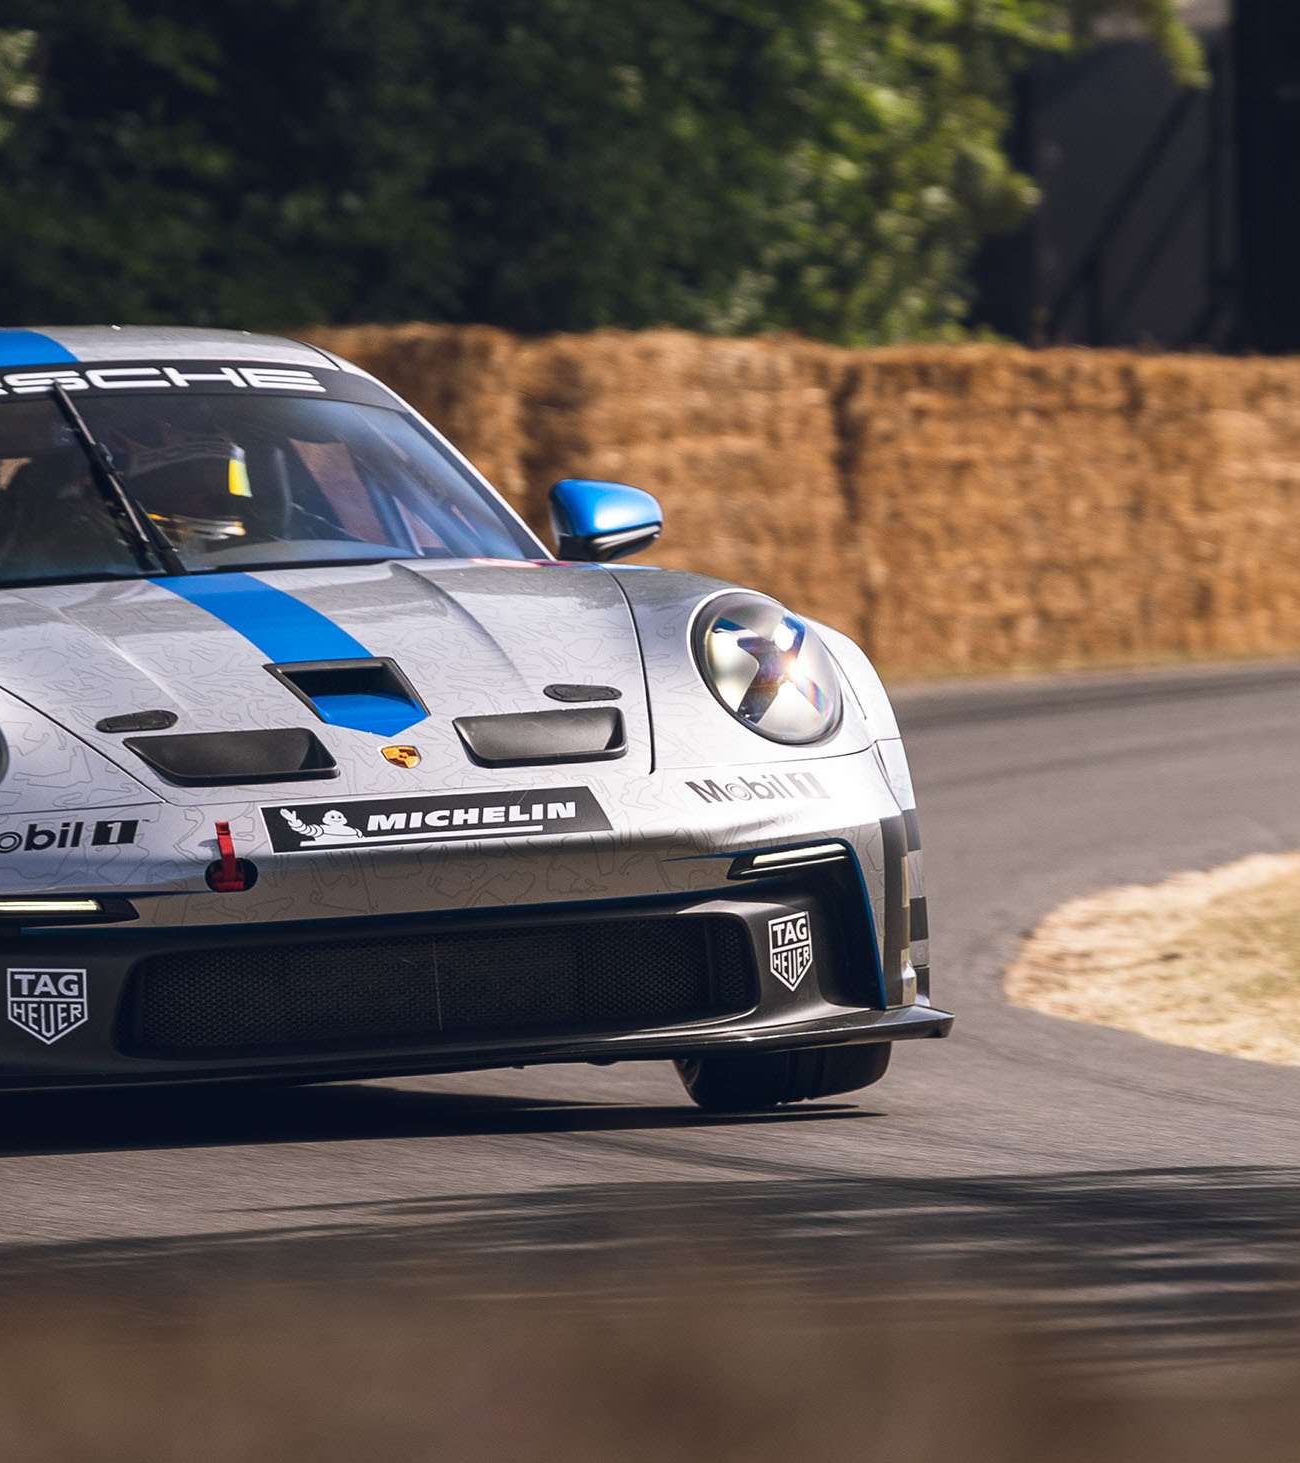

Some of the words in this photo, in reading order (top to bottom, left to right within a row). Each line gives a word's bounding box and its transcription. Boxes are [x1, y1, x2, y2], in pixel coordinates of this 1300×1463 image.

[684, 775, 795, 804] Mobil
[367, 801, 576, 832] MICHELIN
[772, 917, 807, 946] TAG
[773, 946, 810, 985] HEUER
[14, 974, 79, 996] TAG
[13, 1003, 82, 1038] HEUER
